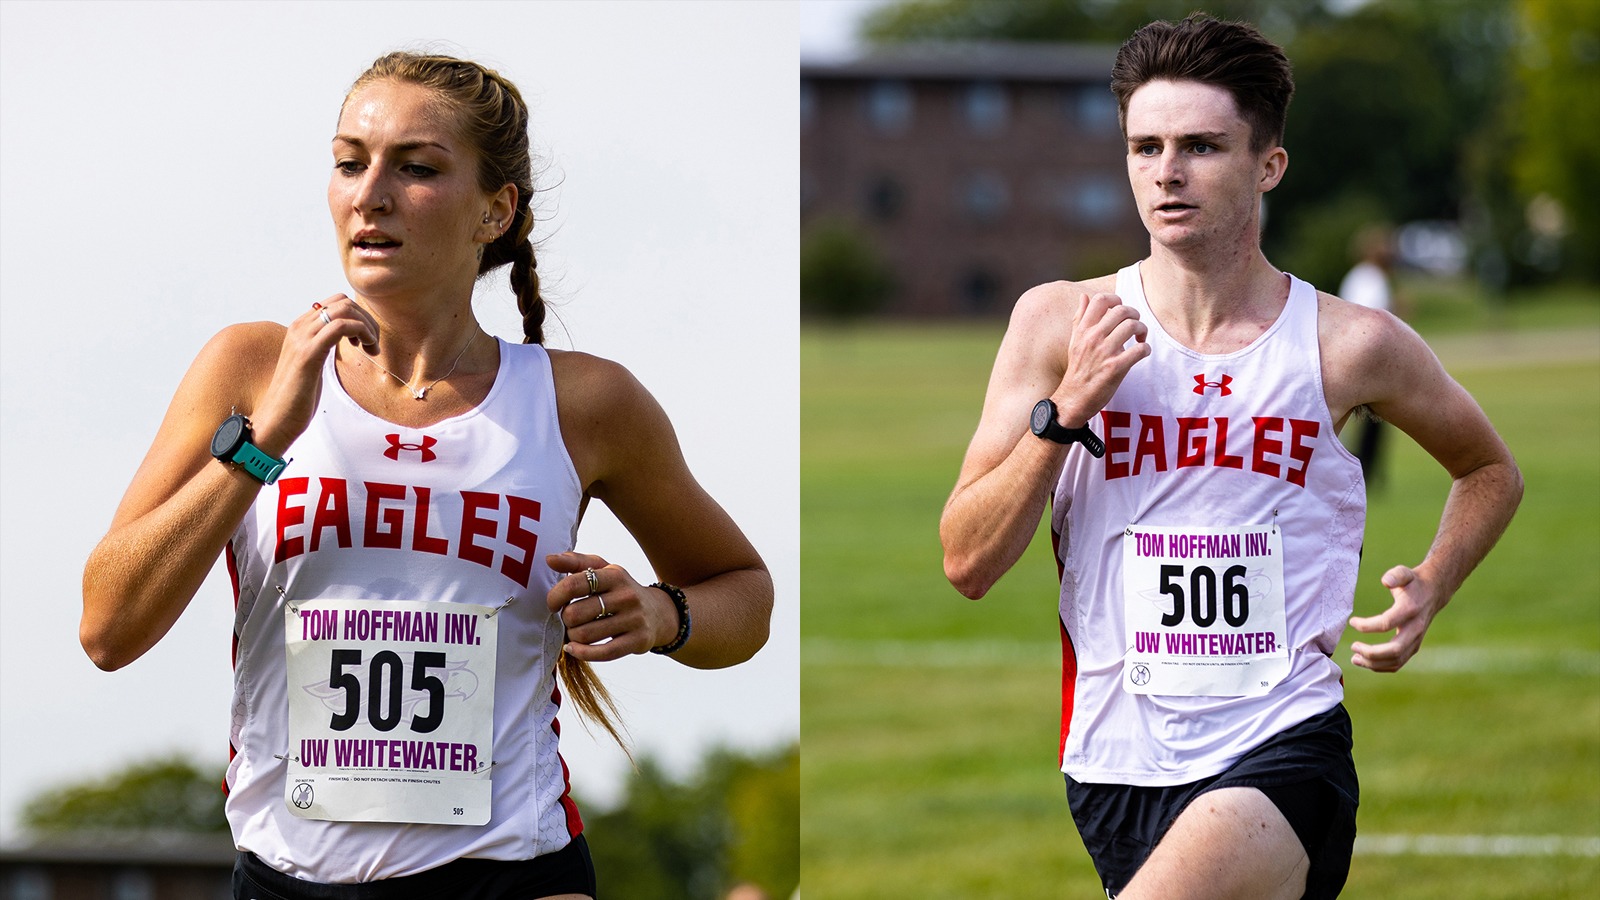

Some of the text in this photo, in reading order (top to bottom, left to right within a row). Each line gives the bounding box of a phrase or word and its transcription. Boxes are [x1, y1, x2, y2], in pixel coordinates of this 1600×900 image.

[1100, 410, 1320, 488] EAGLES
[275, 476, 542, 589] EAGLES
[1134, 532, 1272, 558] TOM HOFFMAN INV.
[1159, 564, 1250, 628] 506
[300, 609, 481, 646] TOM HOFFMAN INV.
[1135, 631, 1276, 655] UW WHITEWATER
[329, 649, 446, 733] 505
[300, 739, 478, 772] UW WHITEWATER
[453, 807, 464, 816] 505
